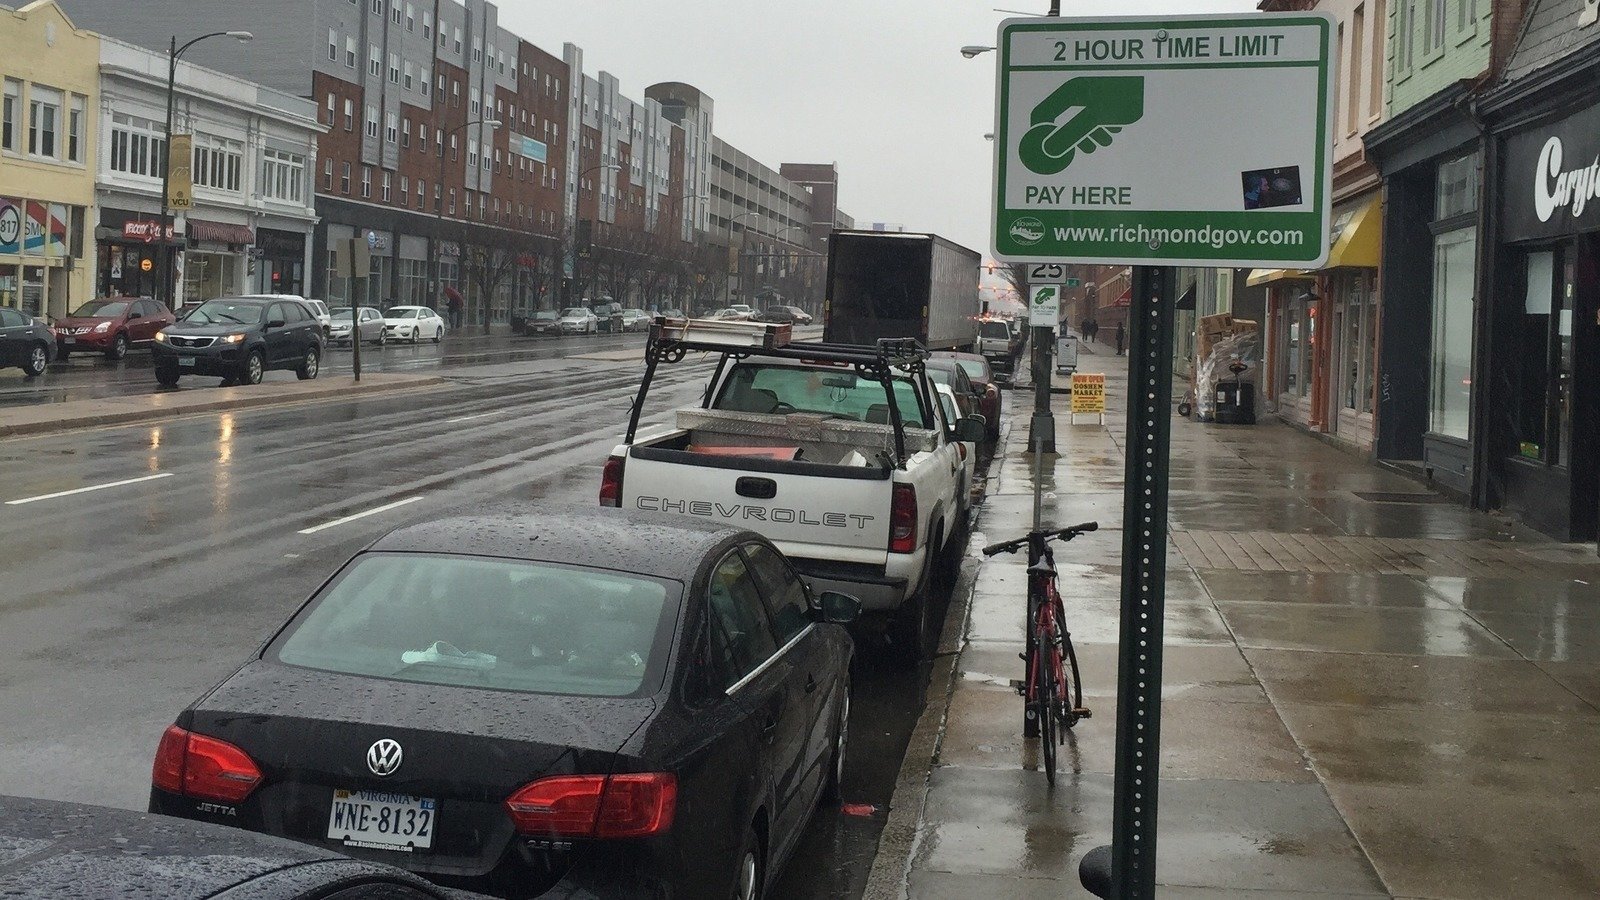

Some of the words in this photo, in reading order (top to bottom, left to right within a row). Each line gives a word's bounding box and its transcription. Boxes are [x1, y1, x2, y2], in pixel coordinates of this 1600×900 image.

[1053, 41, 1067, 62] 2
[1075, 39, 1144, 61] HOUR
[1152, 36, 1210, 59] TIME
[1219, 34, 1285, 57] LIMIT
[1025, 186, 1066, 205] PAY
[1072, 186, 1132, 206] HERE
[0, 219, 17, 234] 817
[1054, 223, 1304, 249] www.richmondgov.com
[636, 495, 875, 530] CHEVROLET
[360, 789, 411, 805] VIRGINIA
[196, 802, 237, 817] JETTA
[334, 801, 431, 837] WNE-8132
